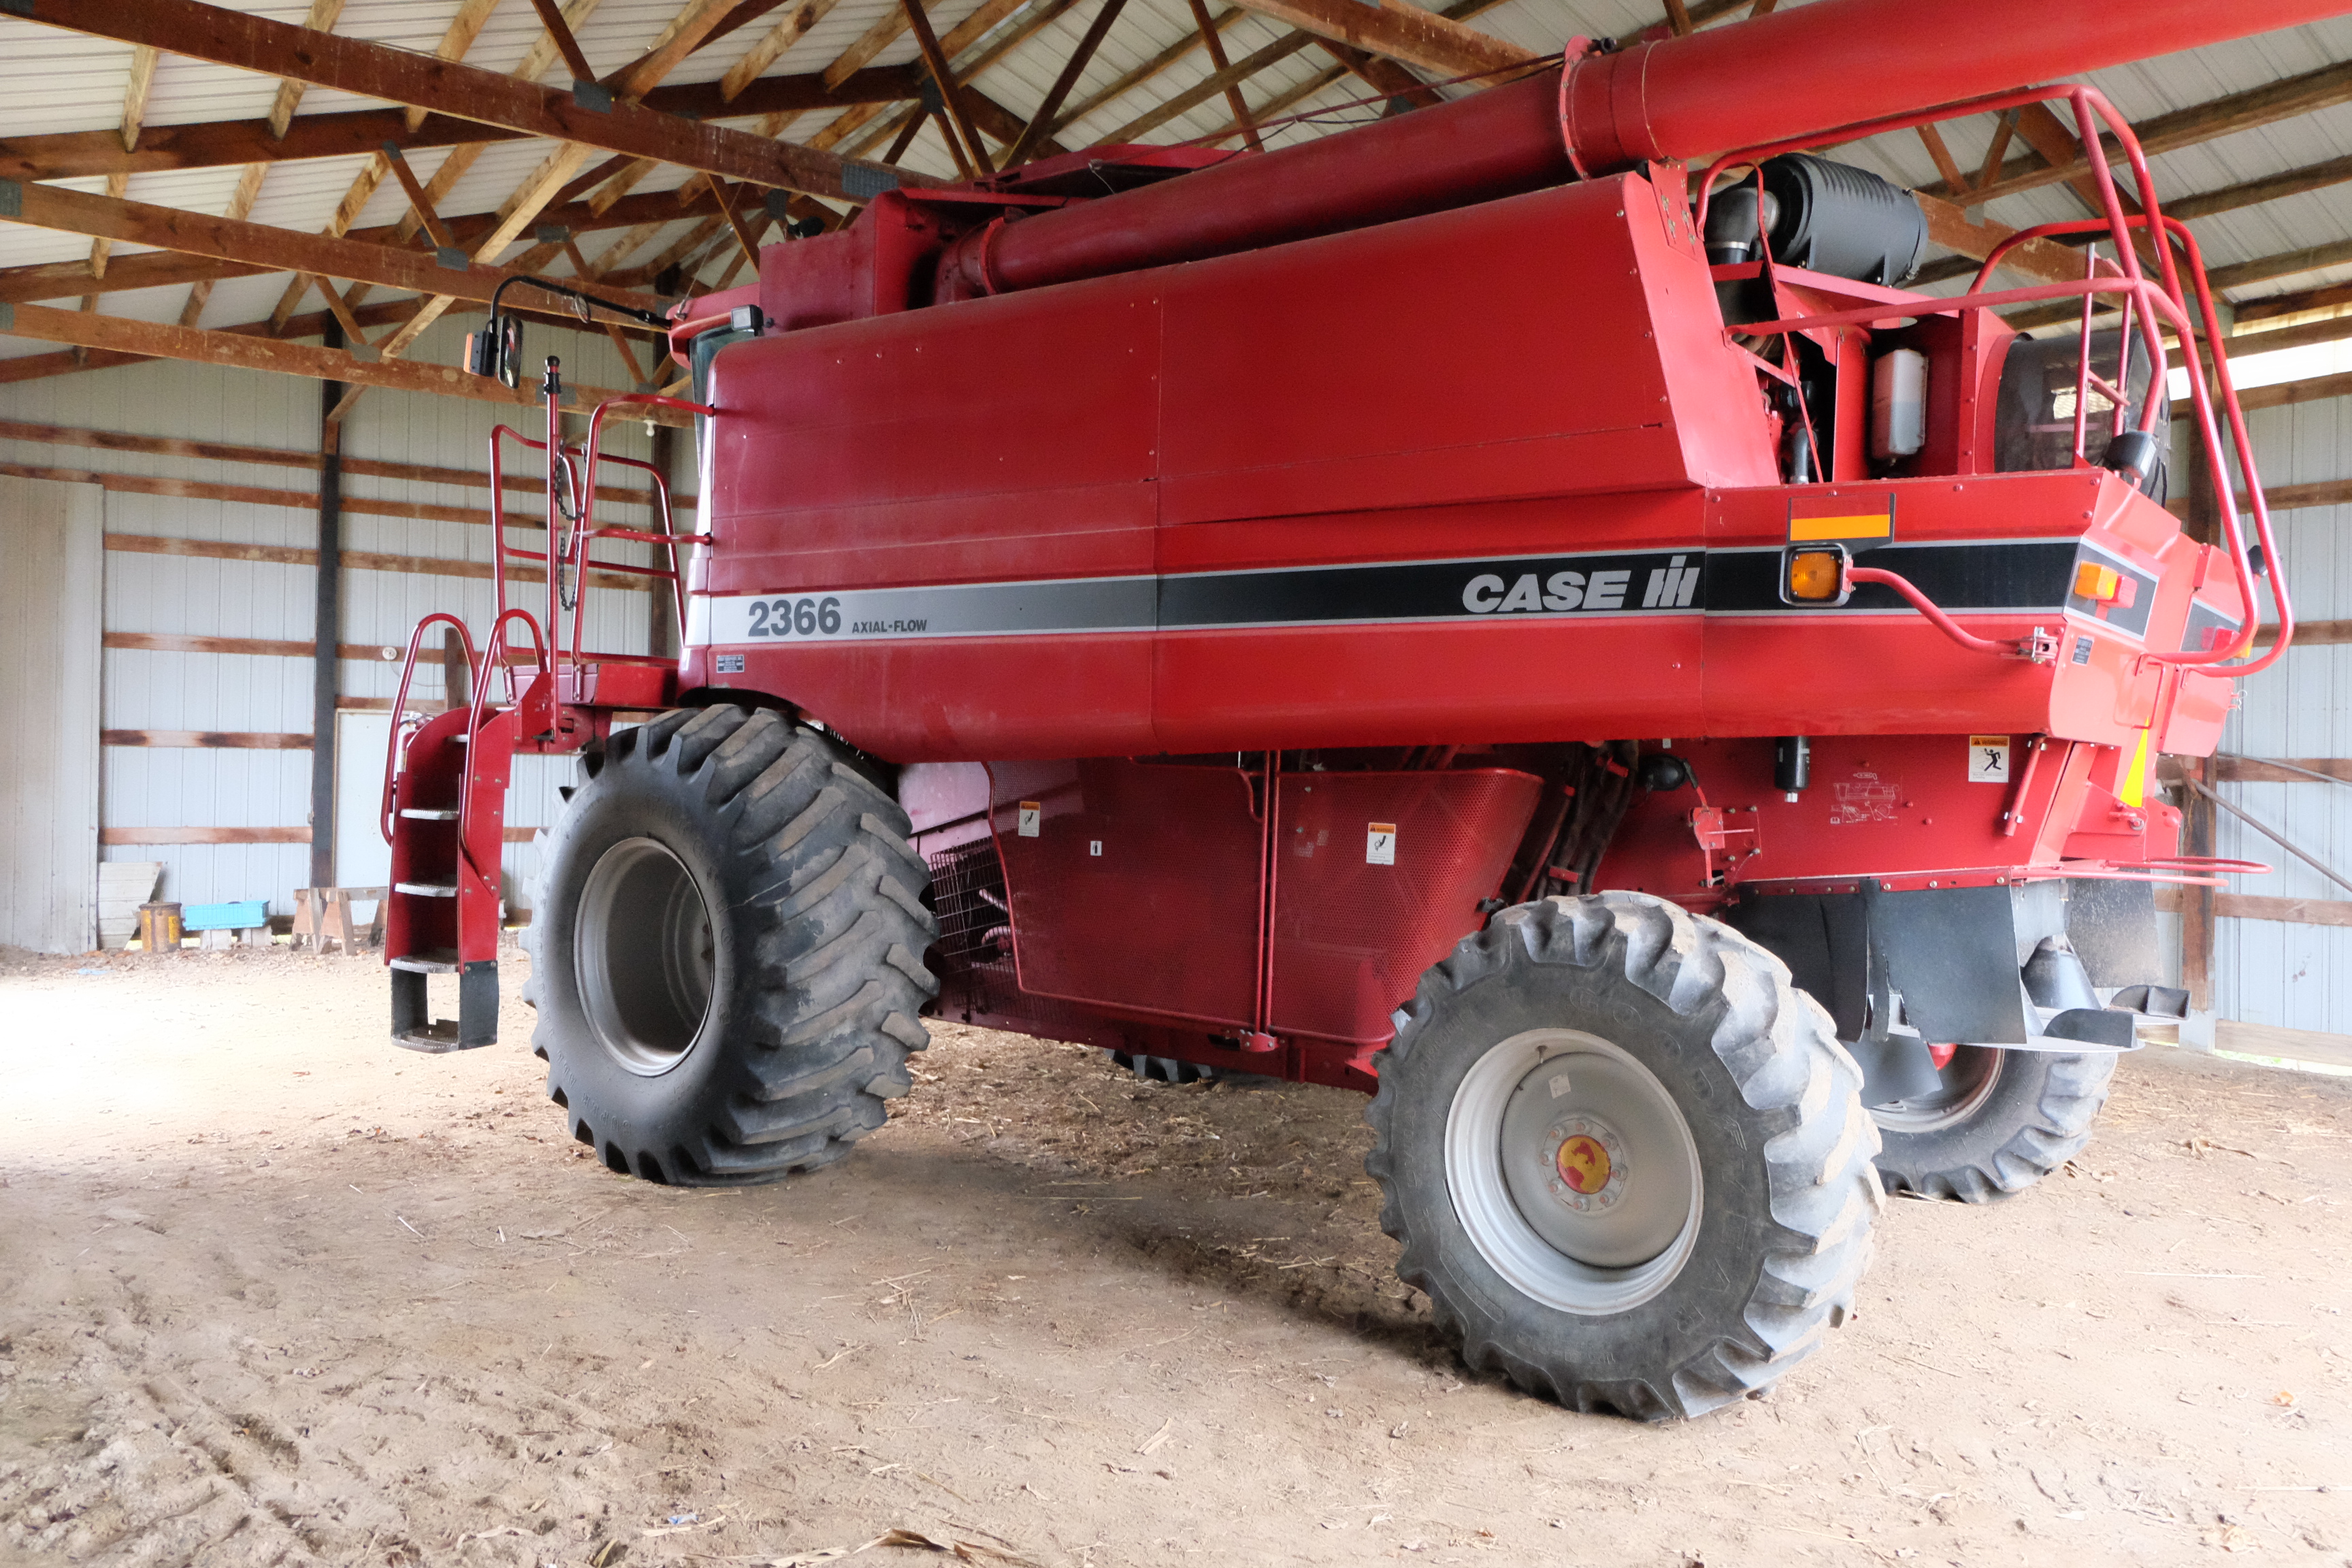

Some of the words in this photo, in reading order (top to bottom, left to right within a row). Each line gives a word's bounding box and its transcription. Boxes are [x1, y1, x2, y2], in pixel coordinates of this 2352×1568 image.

[1462, 570, 1631, 613] CASE
[748, 597, 841, 637] 2366
[852, 619, 928, 634] AXIAL-FLOW
